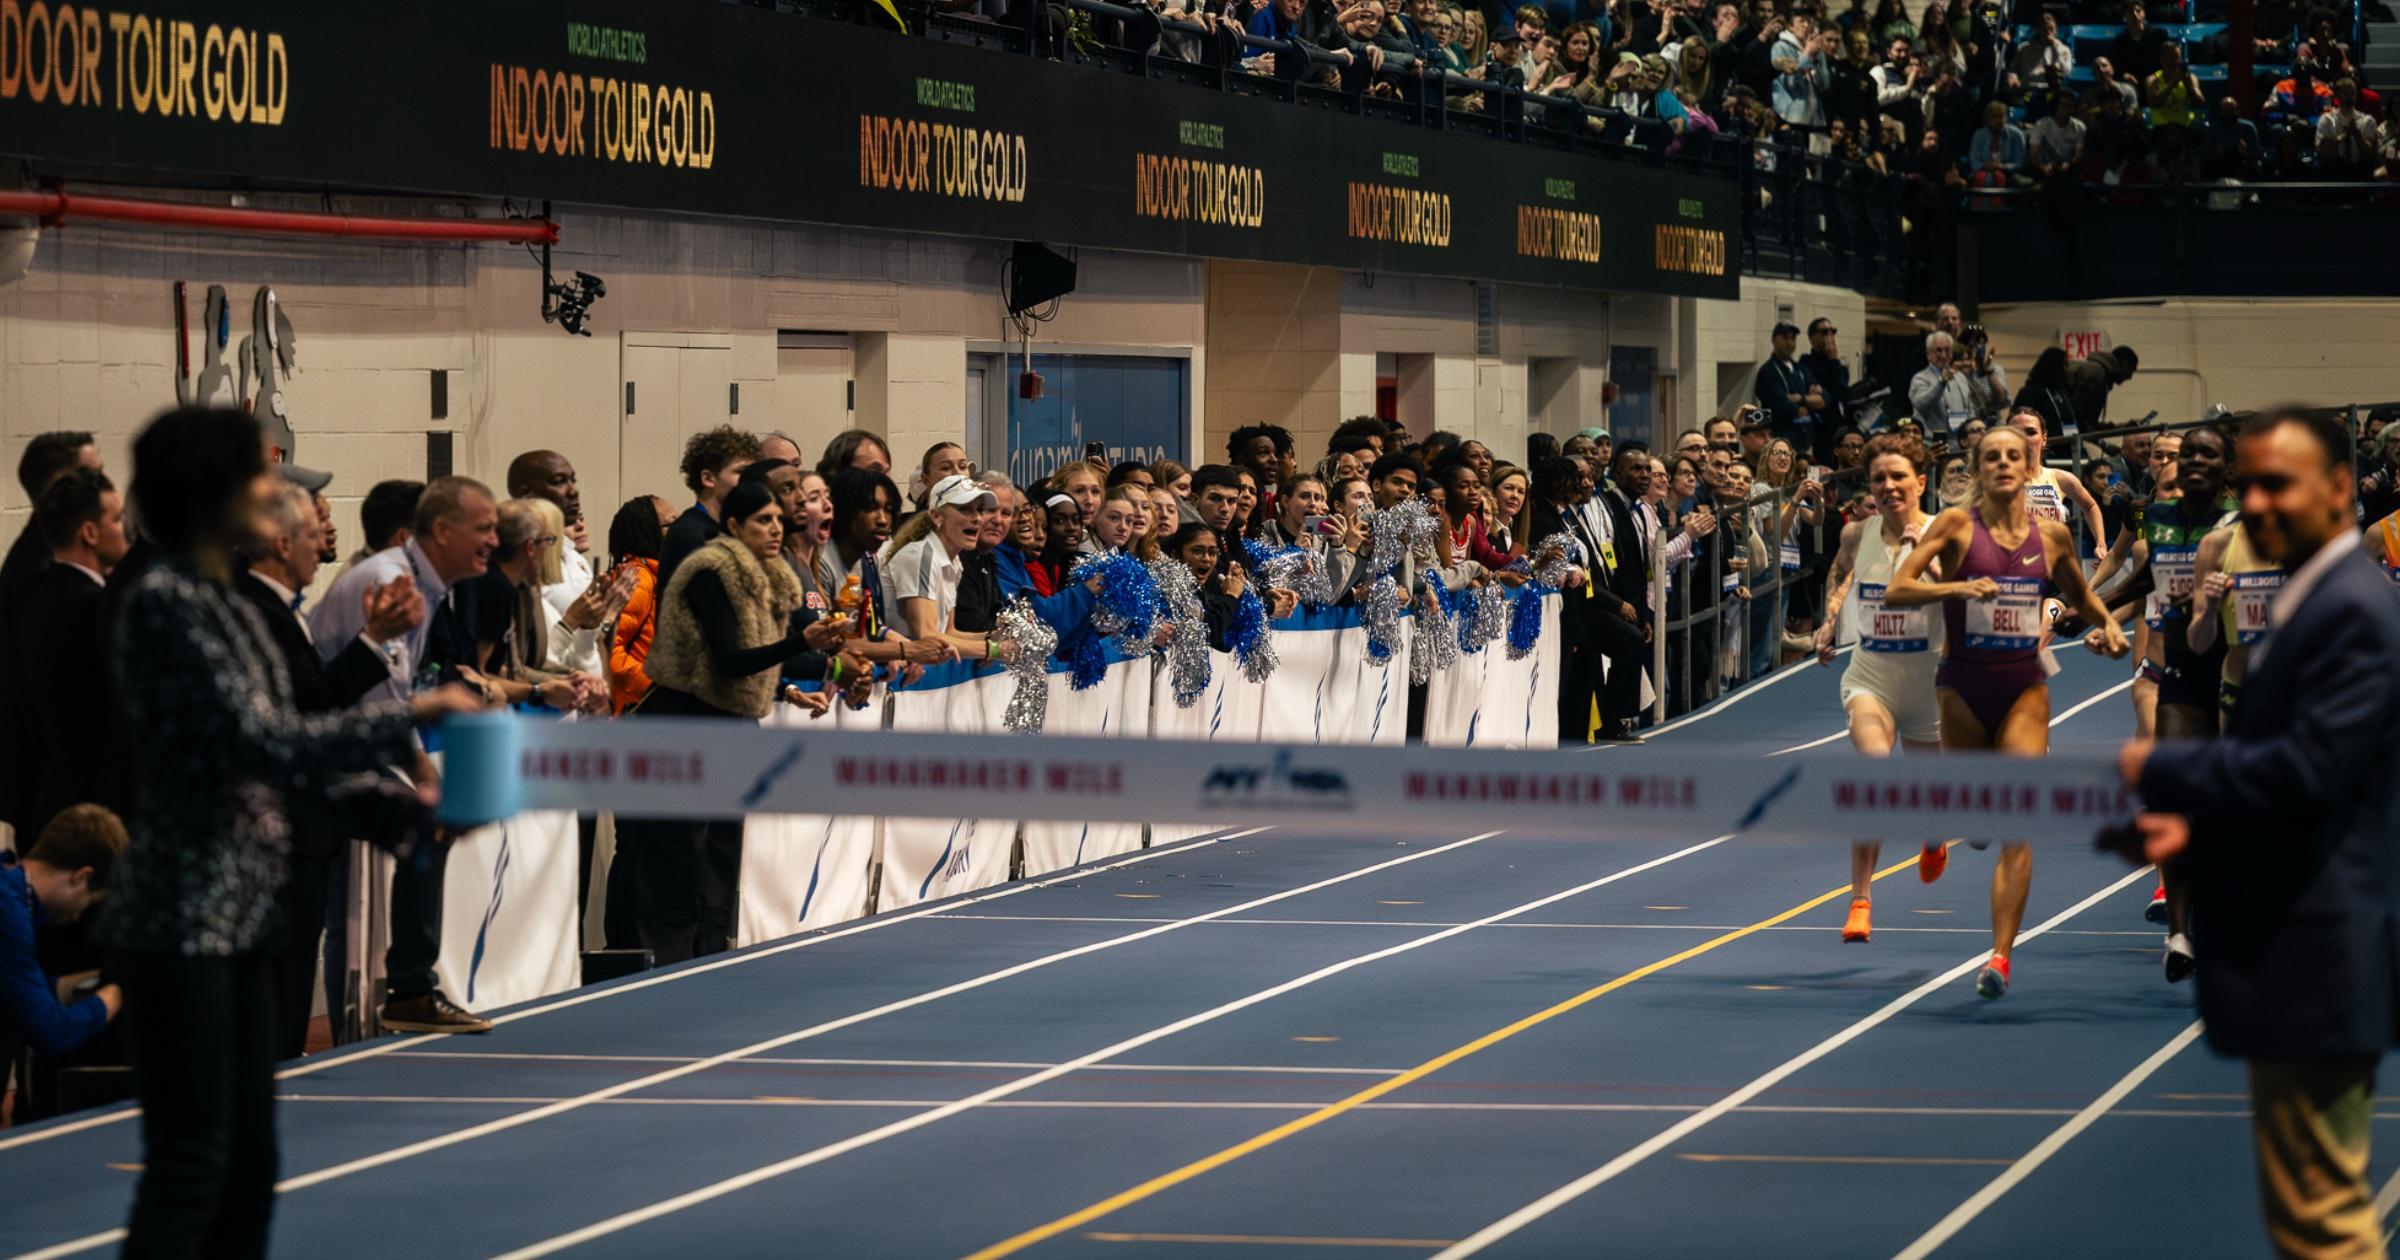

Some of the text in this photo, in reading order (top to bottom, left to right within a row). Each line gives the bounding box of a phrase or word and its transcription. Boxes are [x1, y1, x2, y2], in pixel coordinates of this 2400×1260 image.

[109, 12, 197, 117] TOUR
[202, 23, 288, 126] GOLD
[567, 22, 647, 64] WORLD ATHLETICS
[490, 63, 715, 169] INDOOR TOUR GOLD
[916, 77, 975, 113] WORLD ATHLETICS
[860, 114, 1026, 202] INDOOR TOUR GOLD
[1136, 152, 1263, 227] INDOOR TOUR GOLD
[1348, 181, 1451, 247] INDOOR TOUR GOLD
[1518, 205, 1600, 263] INDOOR TOUR GOLD
[2064, 331, 2102, 359] EXIT
[1873, 613, 1905, 636] HILTZ
[1993, 609, 2020, 632] BELL
